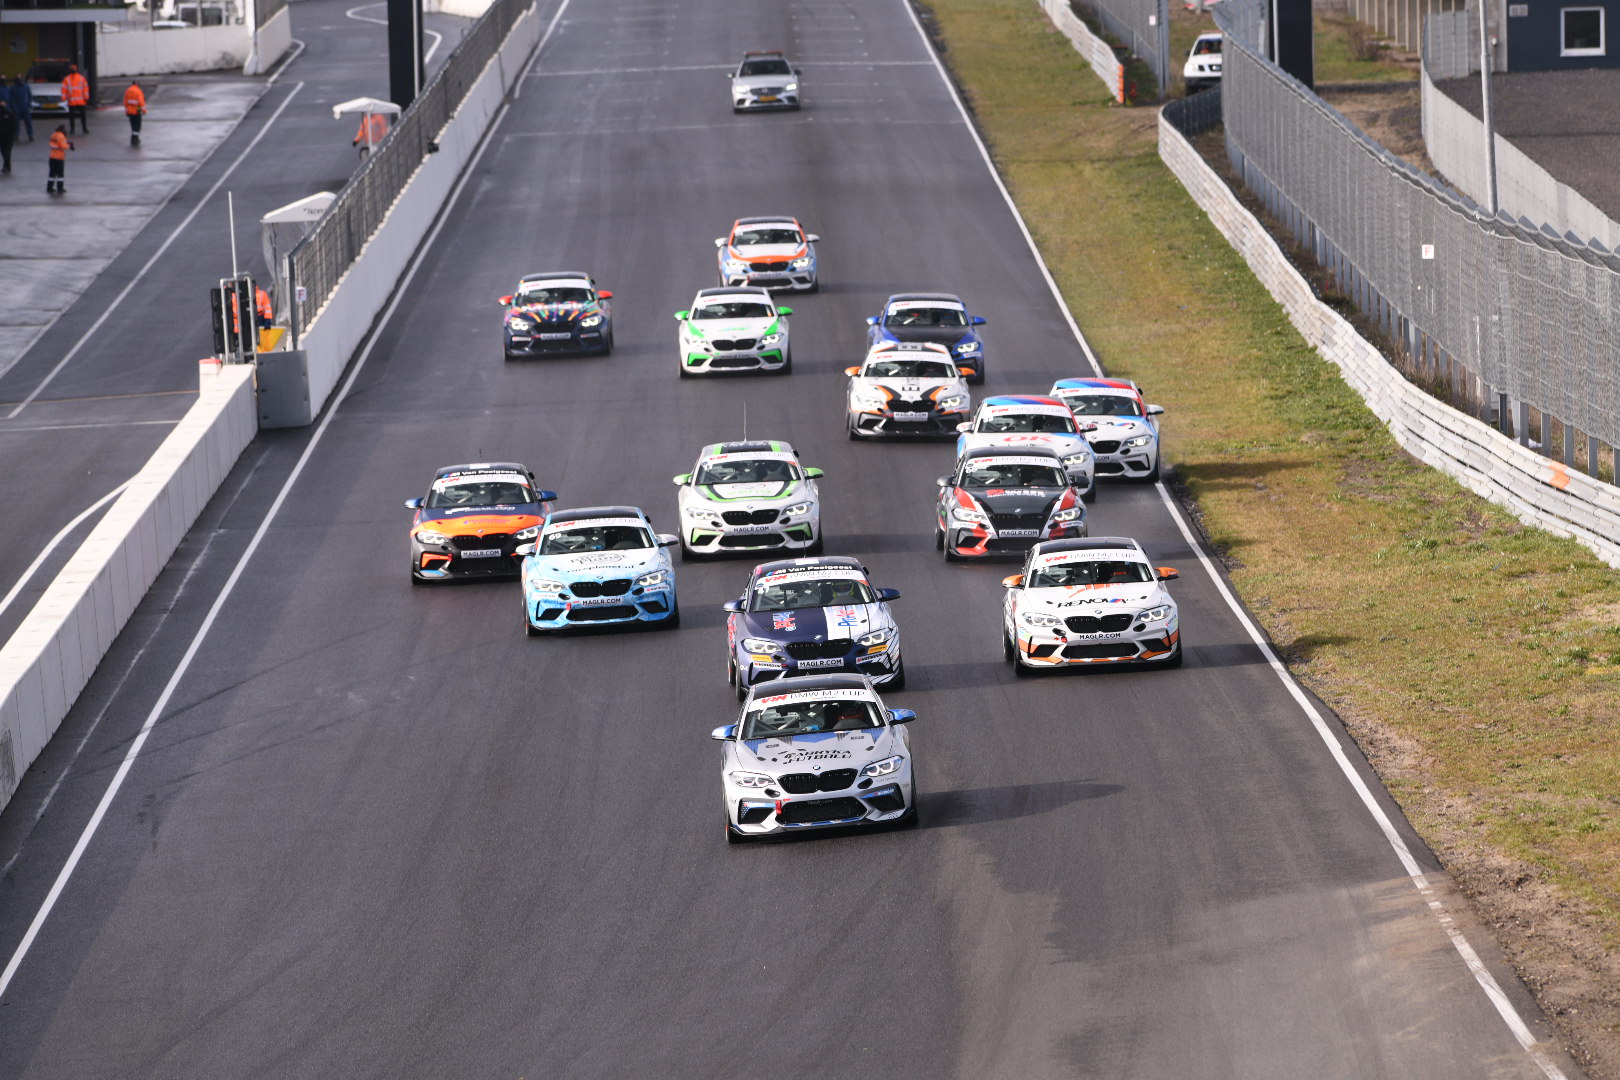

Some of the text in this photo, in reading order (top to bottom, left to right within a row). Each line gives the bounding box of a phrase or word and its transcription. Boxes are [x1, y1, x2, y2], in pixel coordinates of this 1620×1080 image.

[548, 532, 562, 541] 69
[1079, 632, 1121, 640] MAGLR.COM
[800, 659, 842, 668] MAGLR.COM
[790, 690, 819, 700] BMW
[842, 689, 865, 697] CUP
